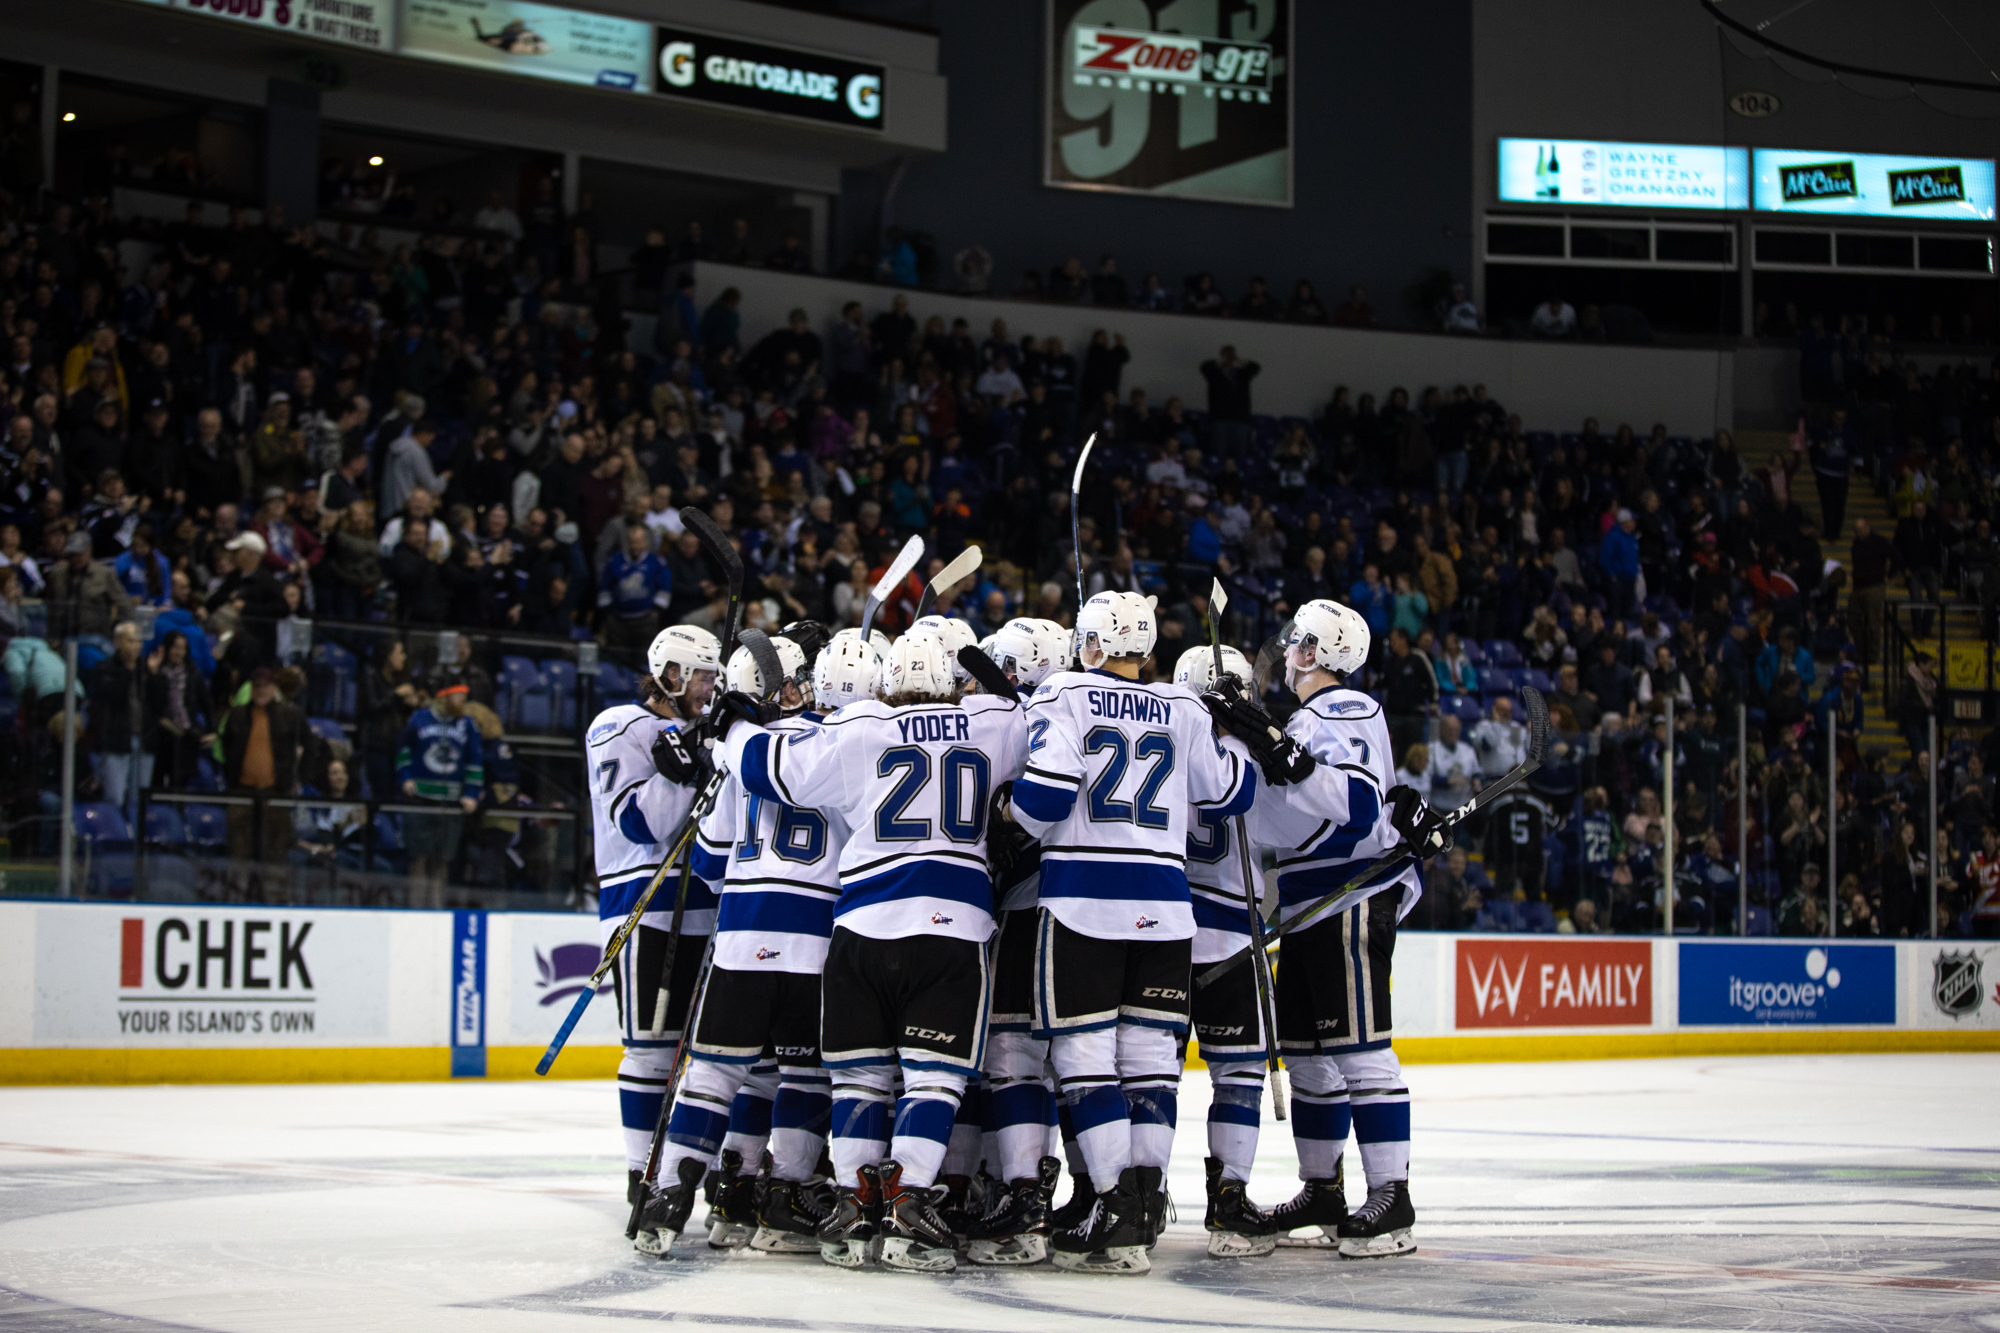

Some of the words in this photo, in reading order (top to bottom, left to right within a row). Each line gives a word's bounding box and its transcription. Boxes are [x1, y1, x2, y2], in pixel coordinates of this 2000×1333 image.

[1083, 33, 1198, 72] Zone
[659, 41, 696, 88] G
[703, 54, 839, 102] GATORADE
[846, 73, 881, 119] G
[1737, 95, 1772, 115] 104
[1608, 151, 1678, 166] WAYNE
[1608, 167, 1705, 181] GRETZKY
[1785, 168, 1854, 198] McCain
[1893, 173, 1962, 202] McCain
[1609, 183, 1717, 198] OKANAGAN
[670, 631, 696, 643] VICTORIA
[1137, 620, 1149, 632] 22
[841, 681, 853, 692] 16
[1087, 690, 1171, 726] SIDAWAY
[897, 713, 970, 744] YODER
[1349, 736, 1371, 766] 7
[1084, 725, 1176, 831] 22
[877, 744, 991, 844] 20
[737, 788, 829, 867] 16
[1509, 811, 1530, 845] 5
[156, 918, 314, 989] CHEK
[461, 938, 476, 1031] WINMAR
[1141, 987, 1188, 1001] CCM
[1540, 963, 1644, 1008] FAMILY
[1729, 974, 1816, 1012] itgroove
[1944, 969, 1973, 1006] NHL
[118, 1010, 170, 1034] YOUR
[178, 1010, 263, 1034] ISLAND'S
[271, 1010, 315, 1033] OWN
[904, 1025, 957, 1044] CCM
[1196, 1023, 1245, 1036] CCM
[773, 1045, 816, 1057] CCM
[919, 1217, 938, 1235] CCM
